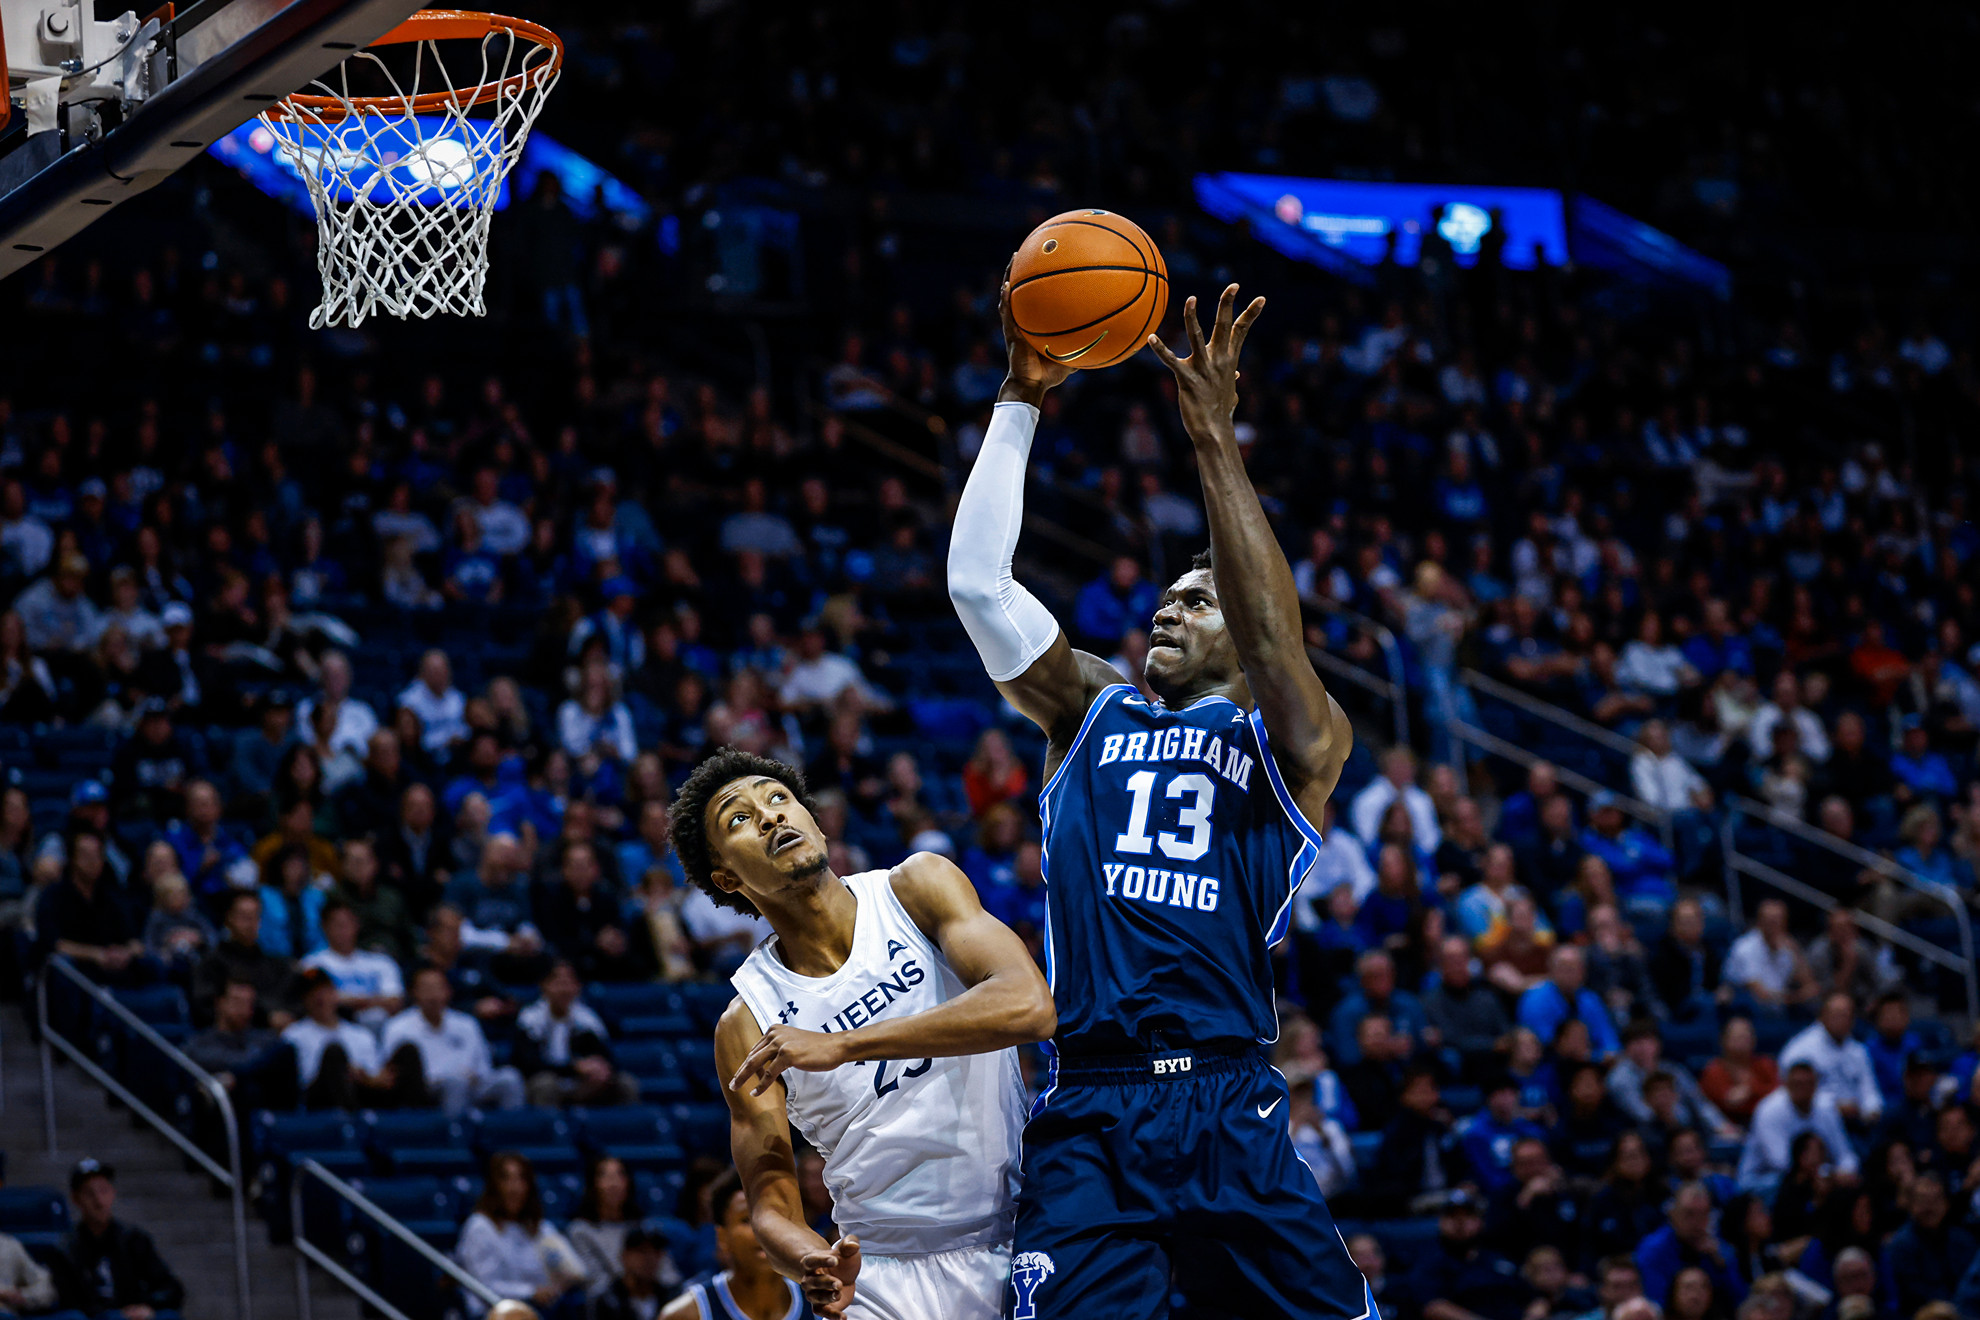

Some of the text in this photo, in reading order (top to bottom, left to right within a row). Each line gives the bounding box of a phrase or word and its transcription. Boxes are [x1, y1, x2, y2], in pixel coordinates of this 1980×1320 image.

[1098, 726, 1254, 793] BRIGHAM
[1114, 769, 1217, 861] 13
[1102, 863, 1219, 912] YOUNG
[821, 959, 925, 1034] UEENS
[1153, 1056, 1192, 1075] BYU
